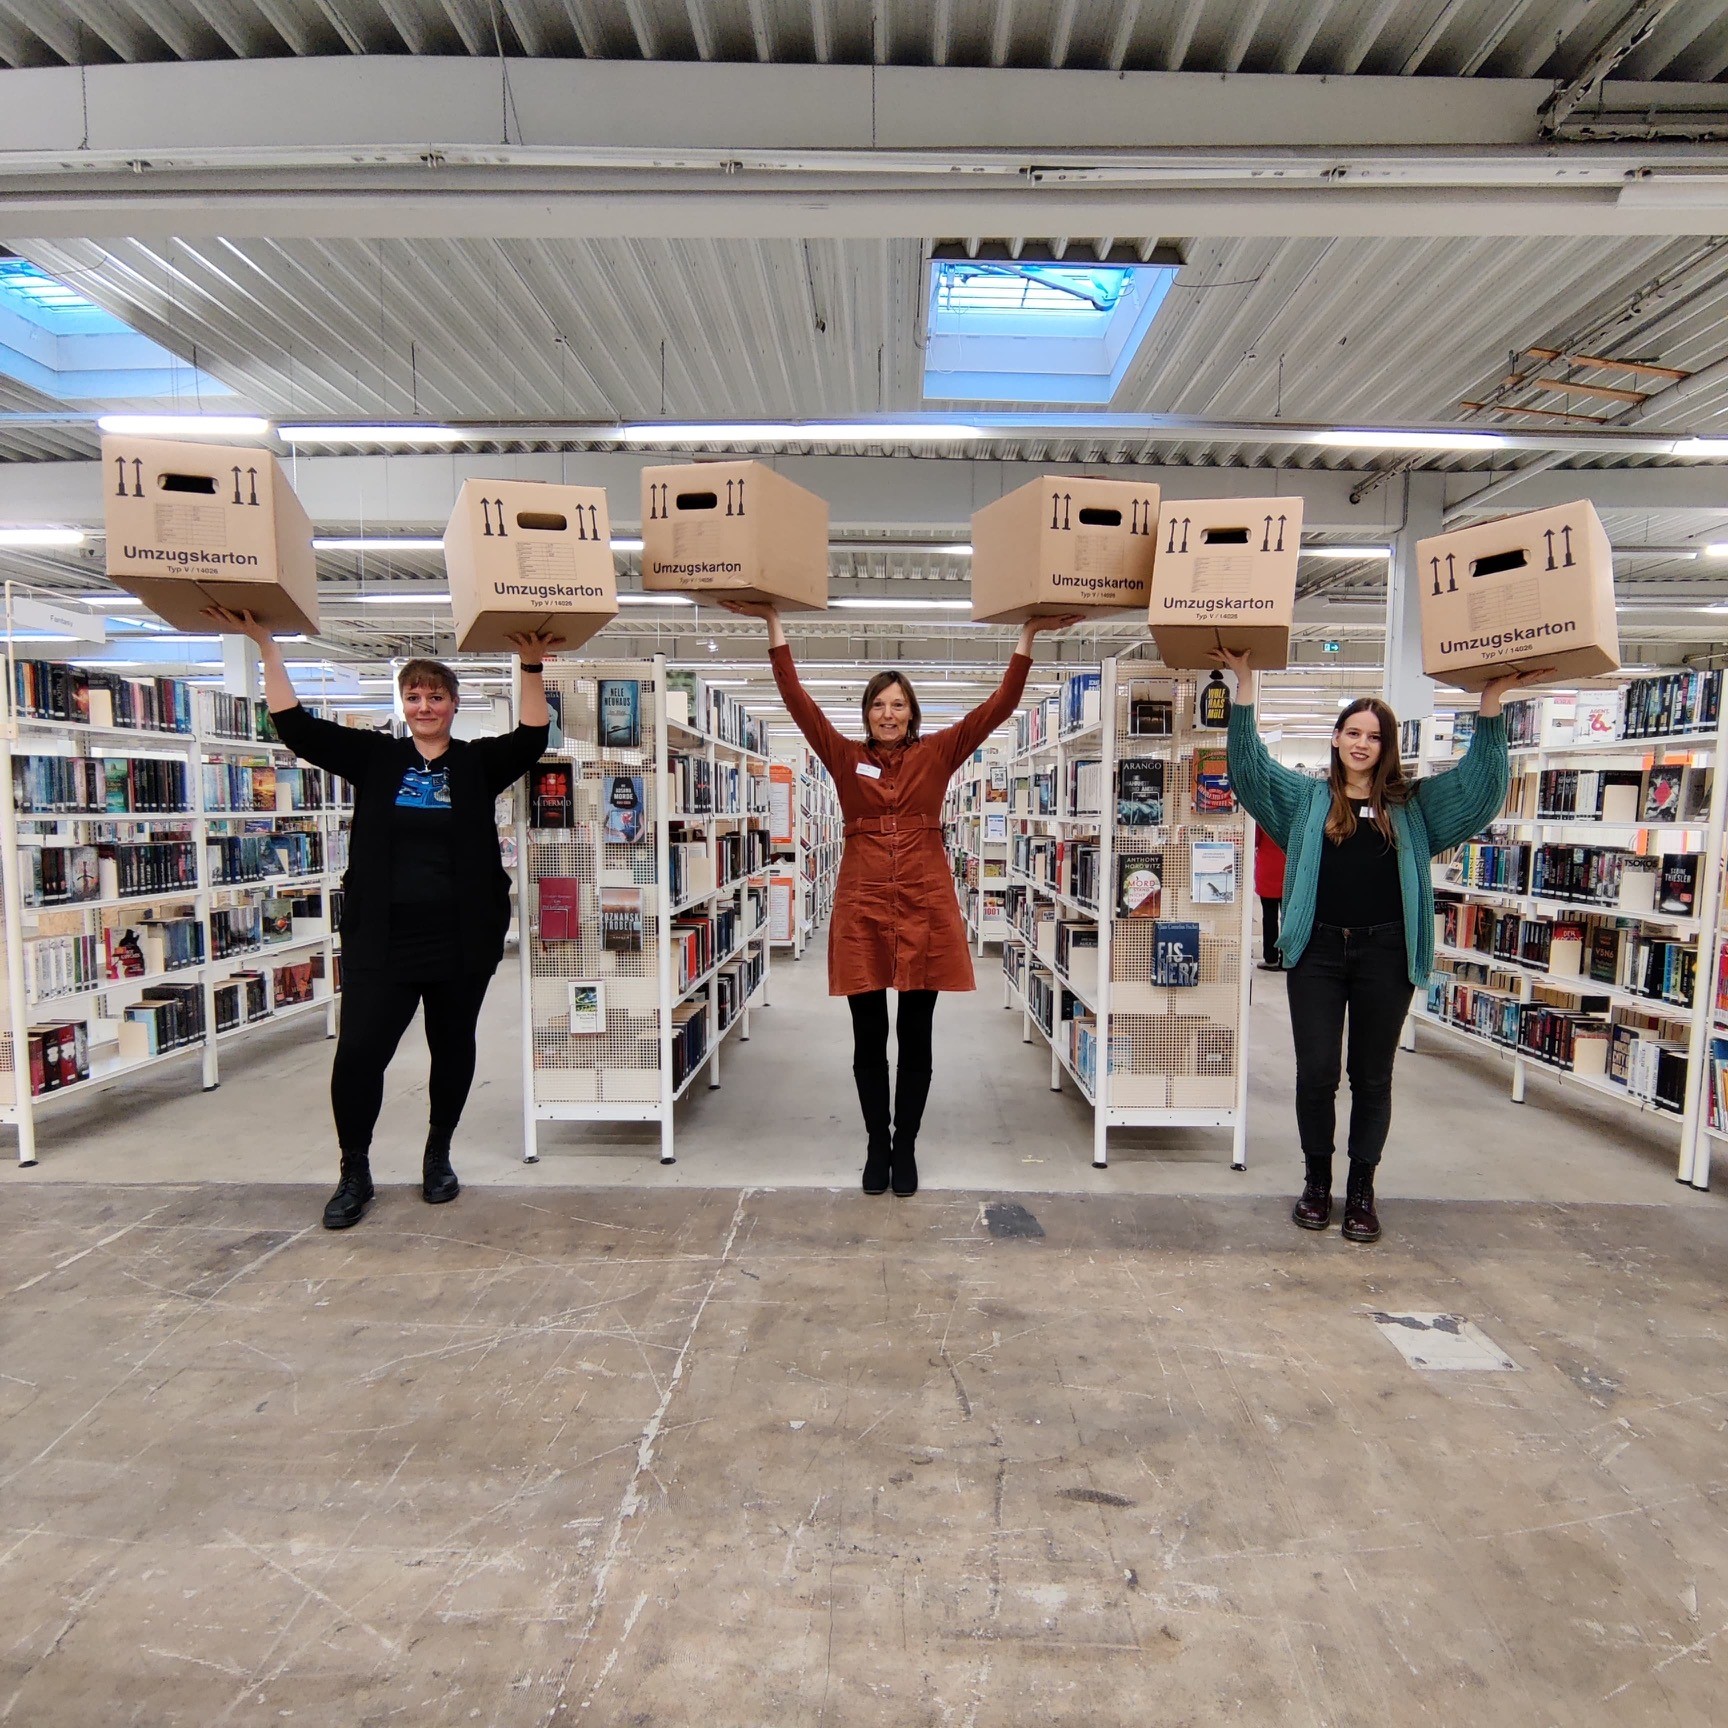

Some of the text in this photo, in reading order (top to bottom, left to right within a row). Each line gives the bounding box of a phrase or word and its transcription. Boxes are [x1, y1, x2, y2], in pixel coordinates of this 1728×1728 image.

[123, 545, 258, 565] Umzugskarton
[167, 565, 182, 574] Typ
[197, 567, 218, 575] 14026
[653, 561, 741, 576] Umzugskarton
[1052, 573, 1144, 590] Umzugskarton
[494, 582, 603, 598] Umzugskarton
[1163, 597, 1274, 612] Umzugskarton
[49, 614, 74, 627] Fantasy
[1439, 620, 1576, 655] Umzugskarton
[1481, 651, 1496, 659] Typ
[1510, 644, 1533, 653] 14026
[610, 687, 624, 697] NELE
[1208, 688, 1226, 698] WOLF
[604, 697, 631, 706] NEUHAUS
[1208, 699, 1225, 708] HAAS
[1123, 762, 1162, 770] ARANGO
[1624, 859, 1659, 868] TSOKOS
[1664, 873, 1692, 883] THIESLER
[984, 907, 1000, 916] 1001
[1157, 941, 1184, 963] EIS
[1157, 961, 1198, 984] HERZ
